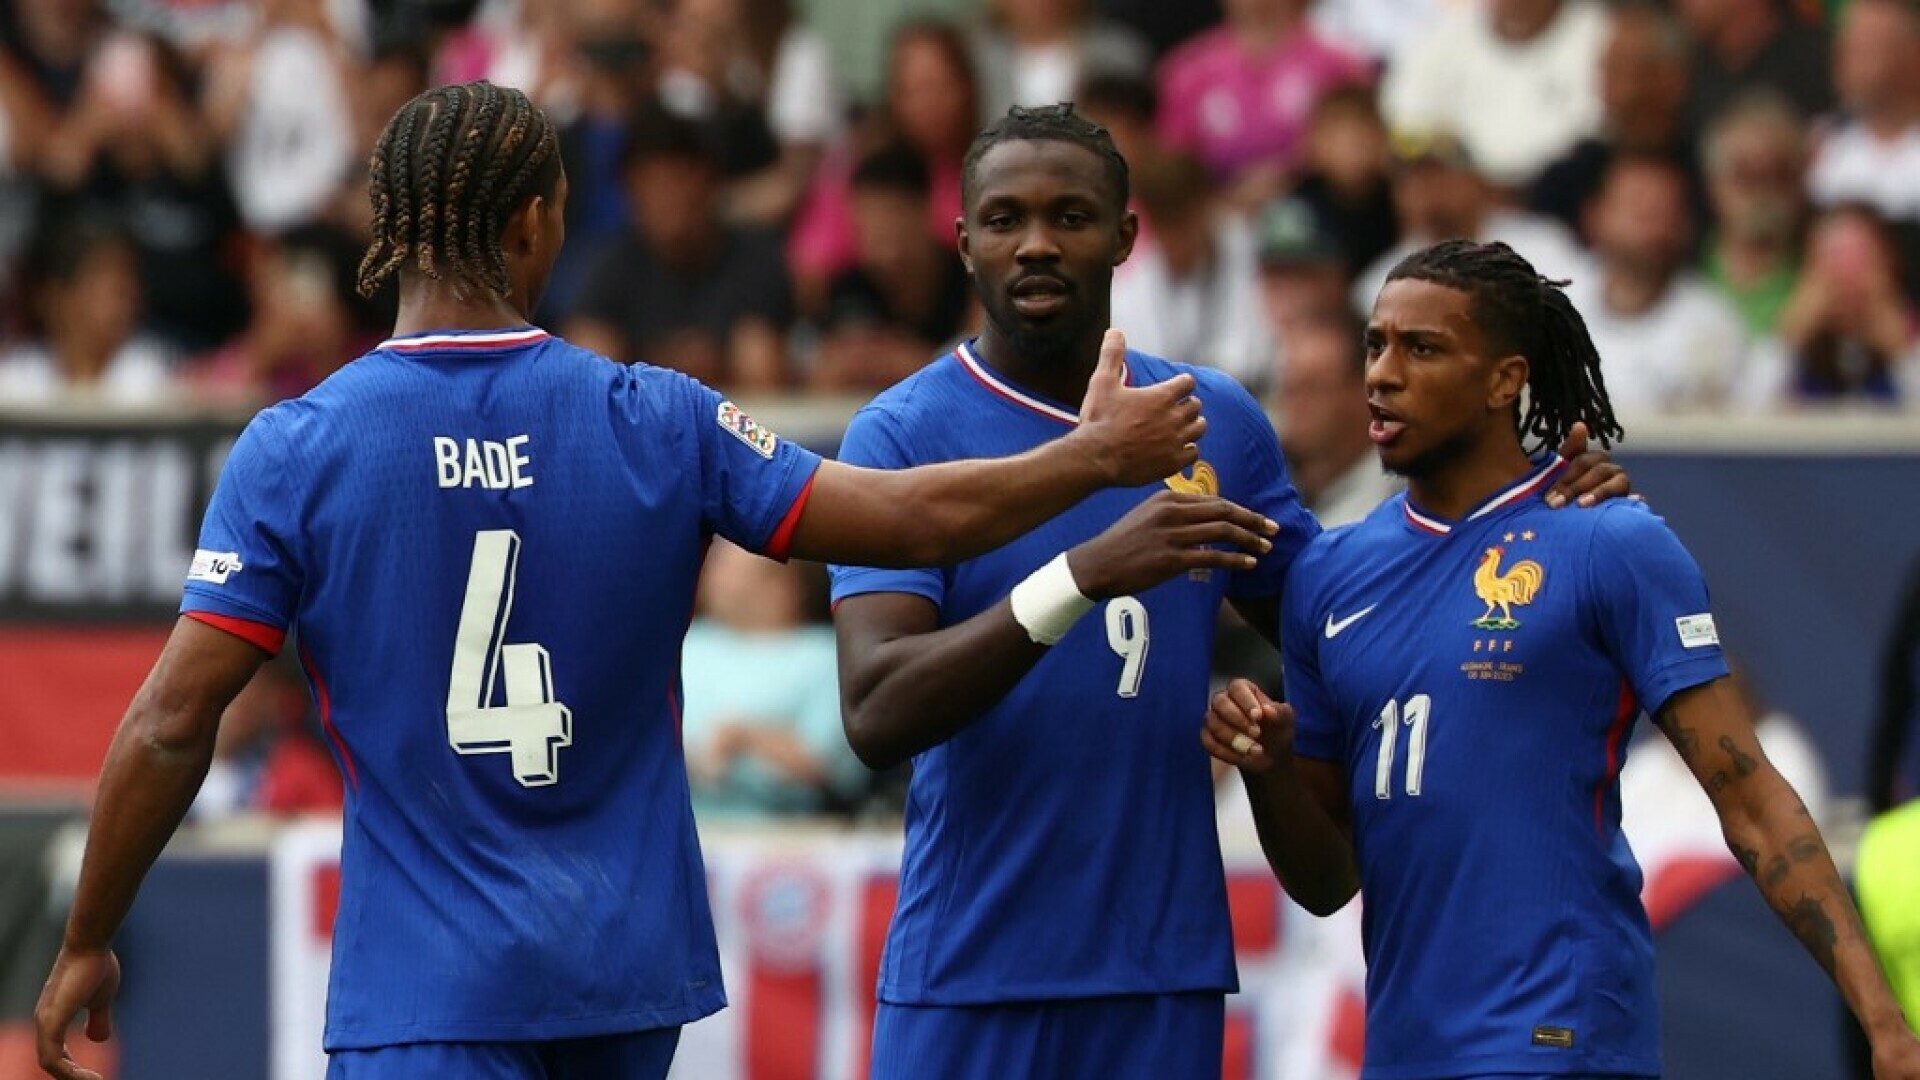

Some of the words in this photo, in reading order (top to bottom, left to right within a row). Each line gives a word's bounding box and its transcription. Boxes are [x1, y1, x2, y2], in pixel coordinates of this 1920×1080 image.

[435, 434, 534, 490] BADE
[447, 529, 573, 786] 4
[1105, 596, 1149, 697] 9
[1372, 694, 1431, 800] 11
